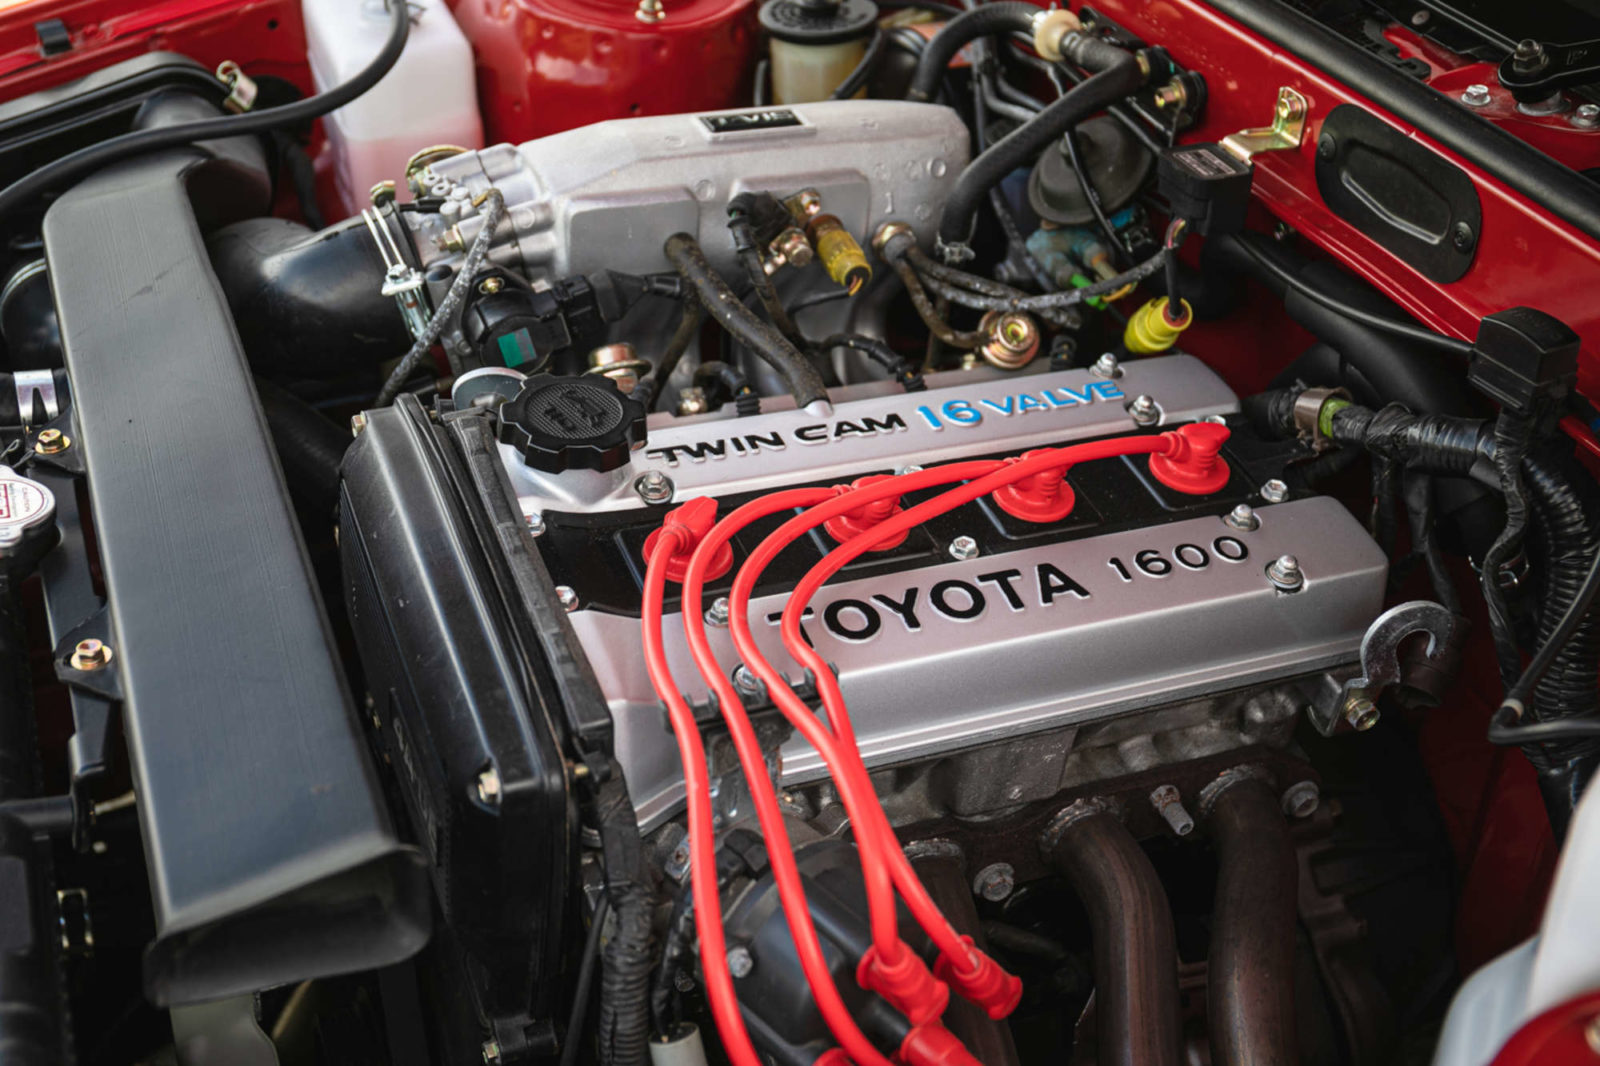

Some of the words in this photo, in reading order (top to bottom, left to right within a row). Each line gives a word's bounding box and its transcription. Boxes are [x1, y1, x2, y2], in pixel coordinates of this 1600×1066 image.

[647, 432, 786, 466] TWIN
[794, 413, 908, 444] CAM
[916, 400, 982, 430] 16
[979, 380, 1126, 415] VALVE
[1107, 535, 1250, 582] 1600
